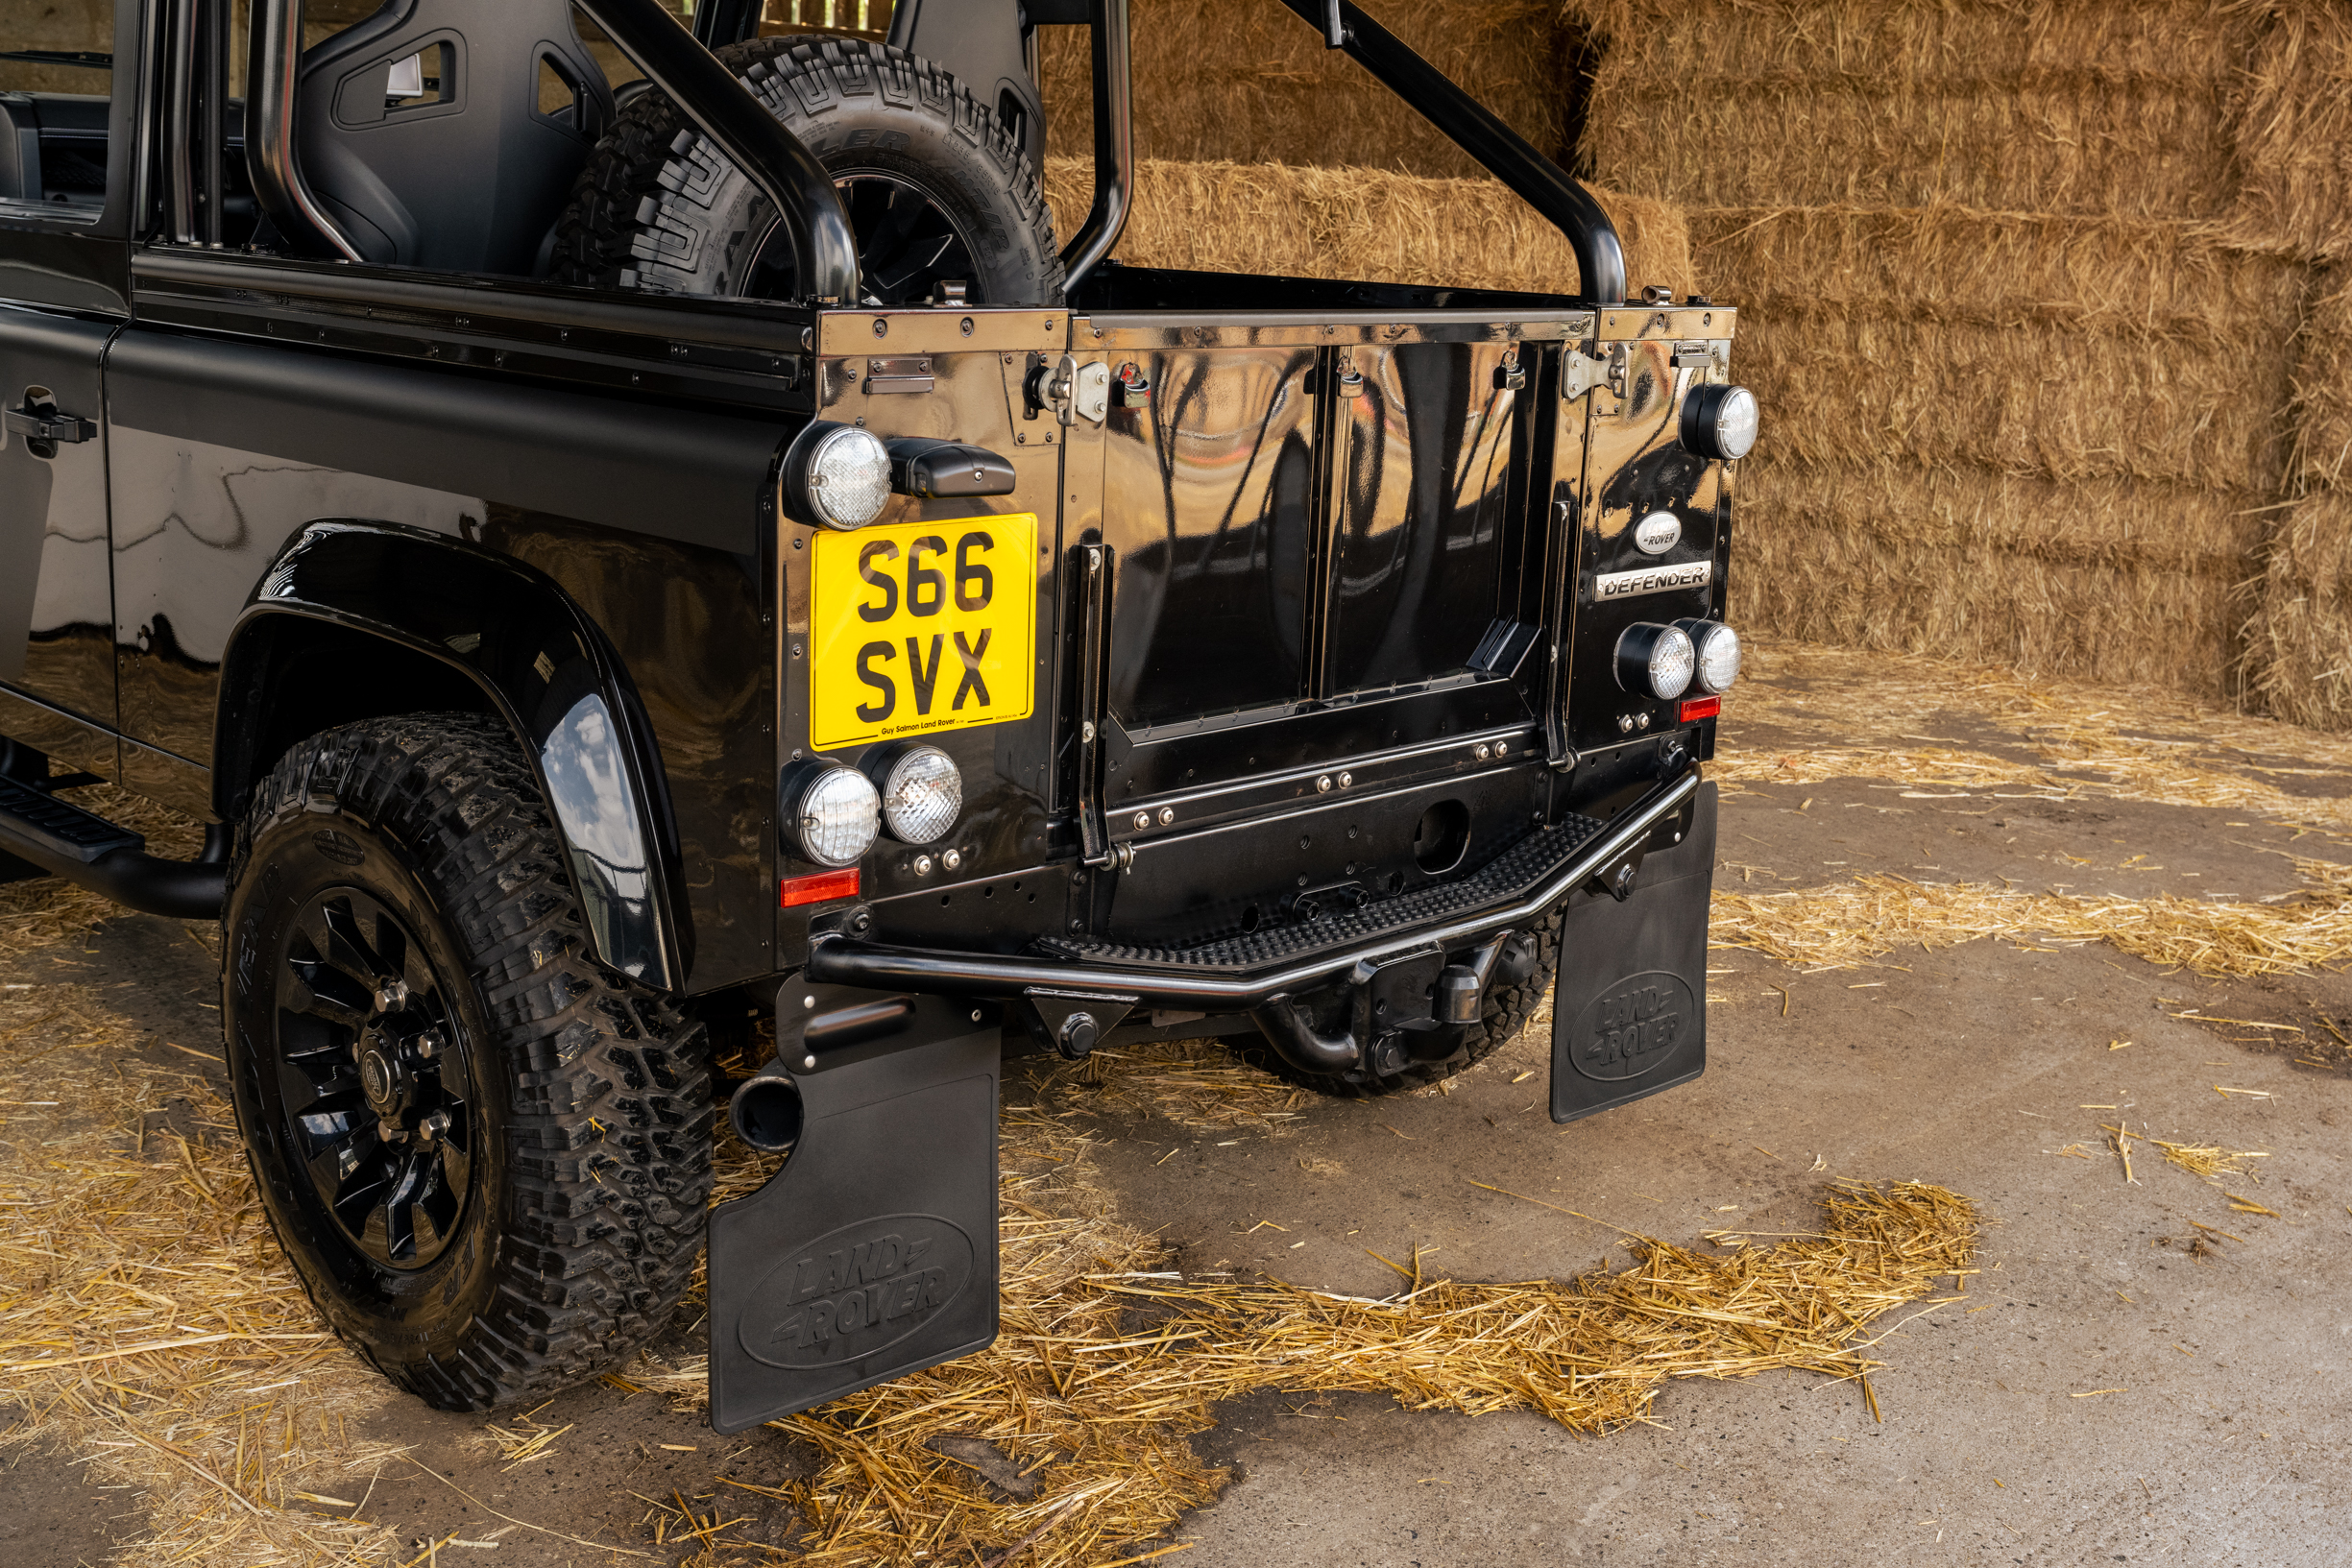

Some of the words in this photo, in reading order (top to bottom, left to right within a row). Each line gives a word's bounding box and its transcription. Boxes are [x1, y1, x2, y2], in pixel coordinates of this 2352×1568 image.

[1647, 532, 1675, 546] ROVER
[857, 531, 995, 623] S66
[1604, 567, 1705, 596] DEFENDER
[855, 627, 992, 724] SVX
[881, 727, 895, 736] Guy
[896, 724, 920, 733] Salmon
[920, 720, 936, 730] Land
[937, 718, 956, 727] Rover
[1596, 986, 1659, 1032] LAND
[1601, 1012, 1679, 1065] ROVER
[787, 1234, 904, 1307] LAND
[797, 1266, 948, 1349] ROVER
